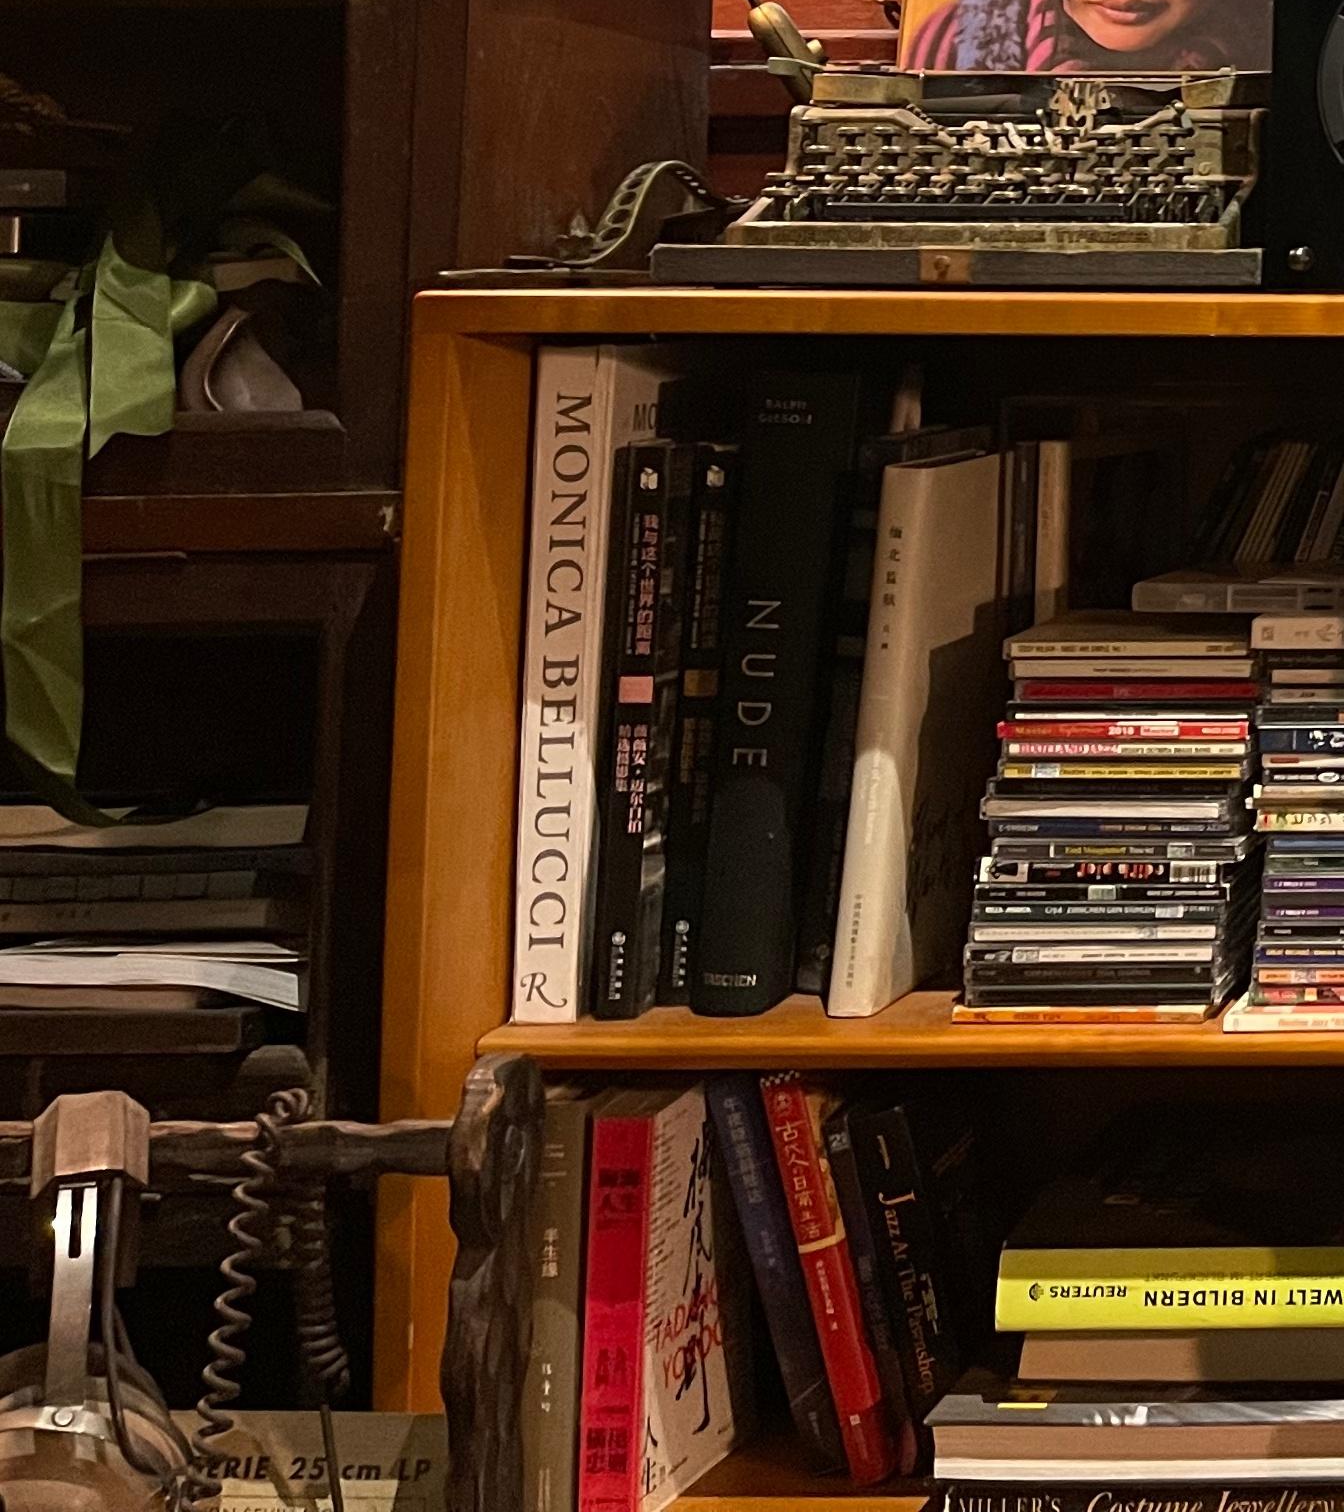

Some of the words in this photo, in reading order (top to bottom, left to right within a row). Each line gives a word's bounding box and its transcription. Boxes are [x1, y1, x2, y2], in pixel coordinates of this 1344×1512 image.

[542, 390, 593, 638] MONICA
[732, 600, 780, 767] NUDE
[527, 652, 582, 950] BELLUCCI
[520, 973, 568, 1008] R
[703, 972, 757, 988] TASCHEN
[878, 1189, 915, 1237] Jazz
[892, 1240, 909, 1262] At
[899, 1264, 916, 1299] The
[1048, 1284, 1128, 1299] REUTERS
[1143, 1289, 1246, 1308] BILDERN
[1253, 1289, 1277, 1306] IN
[1284, 1289, 1344, 1306] WELT
[288, 1455, 328, 1480] 25
[340, 1463, 381, 1480] cm
[397, 1457, 432, 1481] LP
[1086, 1490, 1203, 1512] Costume
